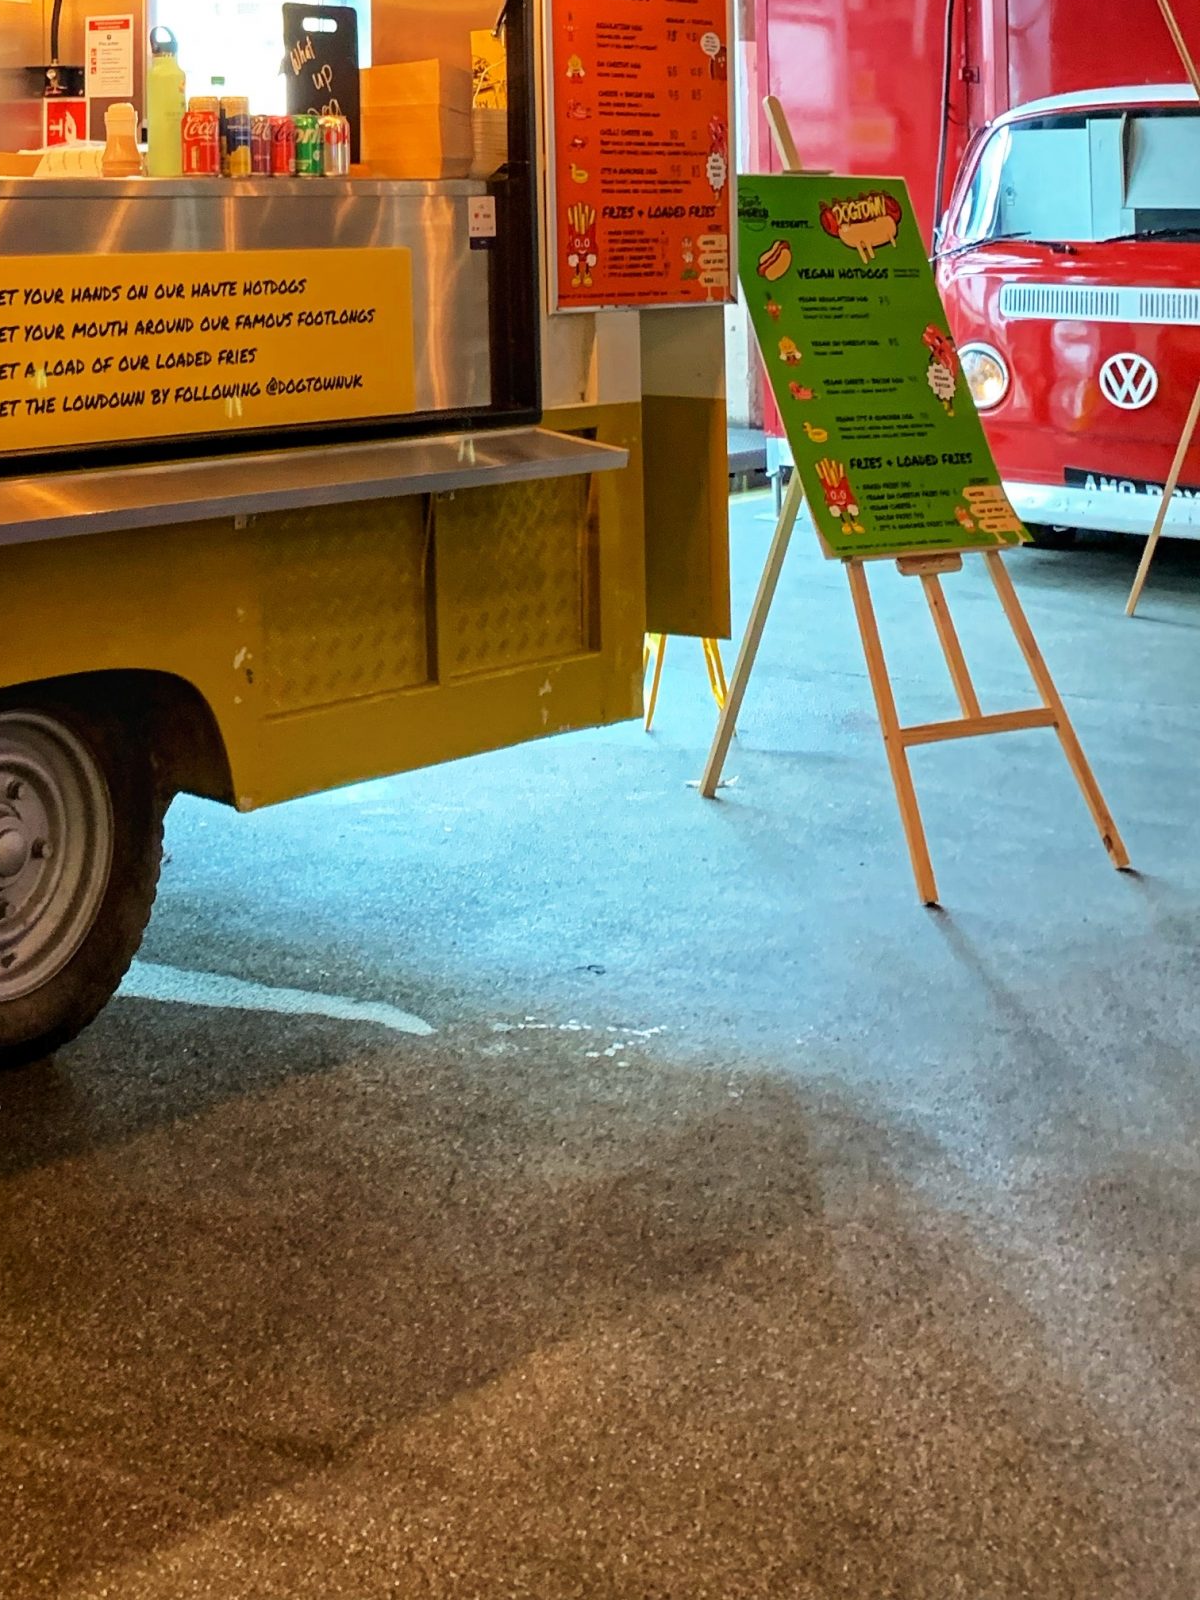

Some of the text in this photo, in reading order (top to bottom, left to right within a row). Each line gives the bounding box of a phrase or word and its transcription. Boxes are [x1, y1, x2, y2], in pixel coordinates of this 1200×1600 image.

[290, 36, 315, 76] What
[312, 64, 332, 92] up
[602, 206, 635, 219] FRIES
[648, 206, 685, 218] LOADED
[688, 206, 717, 218] FRIES
[832, 196, 886, 226] DOGTOWN
[797, 268, 834, 280] VEGAN
[839, 268, 888, 280] HOTDOGS
[23, 288, 64, 305] YOUR
[71, 285, 122, 303] HANDS
[127, 285, 148, 300] ON
[154, 283, 186, 299] OUR
[191, 281, 237, 297] HAUTE
[243, 278, 307, 296] HOTDOGS
[24, 324, 65, 342] YOUR
[72, 320, 128, 338] MOUTH
[135, 318, 194, 336] AROUND
[200, 316, 230, 332] OUR
[235, 312, 293, 330] FAMOUS
[298, 308, 376, 327] FOOTLONGS
[24, 361, 36, 378] A
[44, 359, 84, 377] LOAD
[93, 357, 113, 374] OF
[119, 354, 150, 371] OUR
[157, 351, 212, 369] LOADED
[218, 348, 258, 366] FRIES
[25, 397, 55, 415] THE
[63, 391, 145, 412] LOWDOWN
[152, 389, 170, 407] BY
[175, 383, 261, 403] FOLLOWING
[266, 373, 363, 397] @DOGTOWNUK
[1099, 352, 1159, 410] VW
[850, 457, 882, 470] FRIES
[896, 454, 938, 468] LOADED
[942, 452, 972, 465] FRIES
